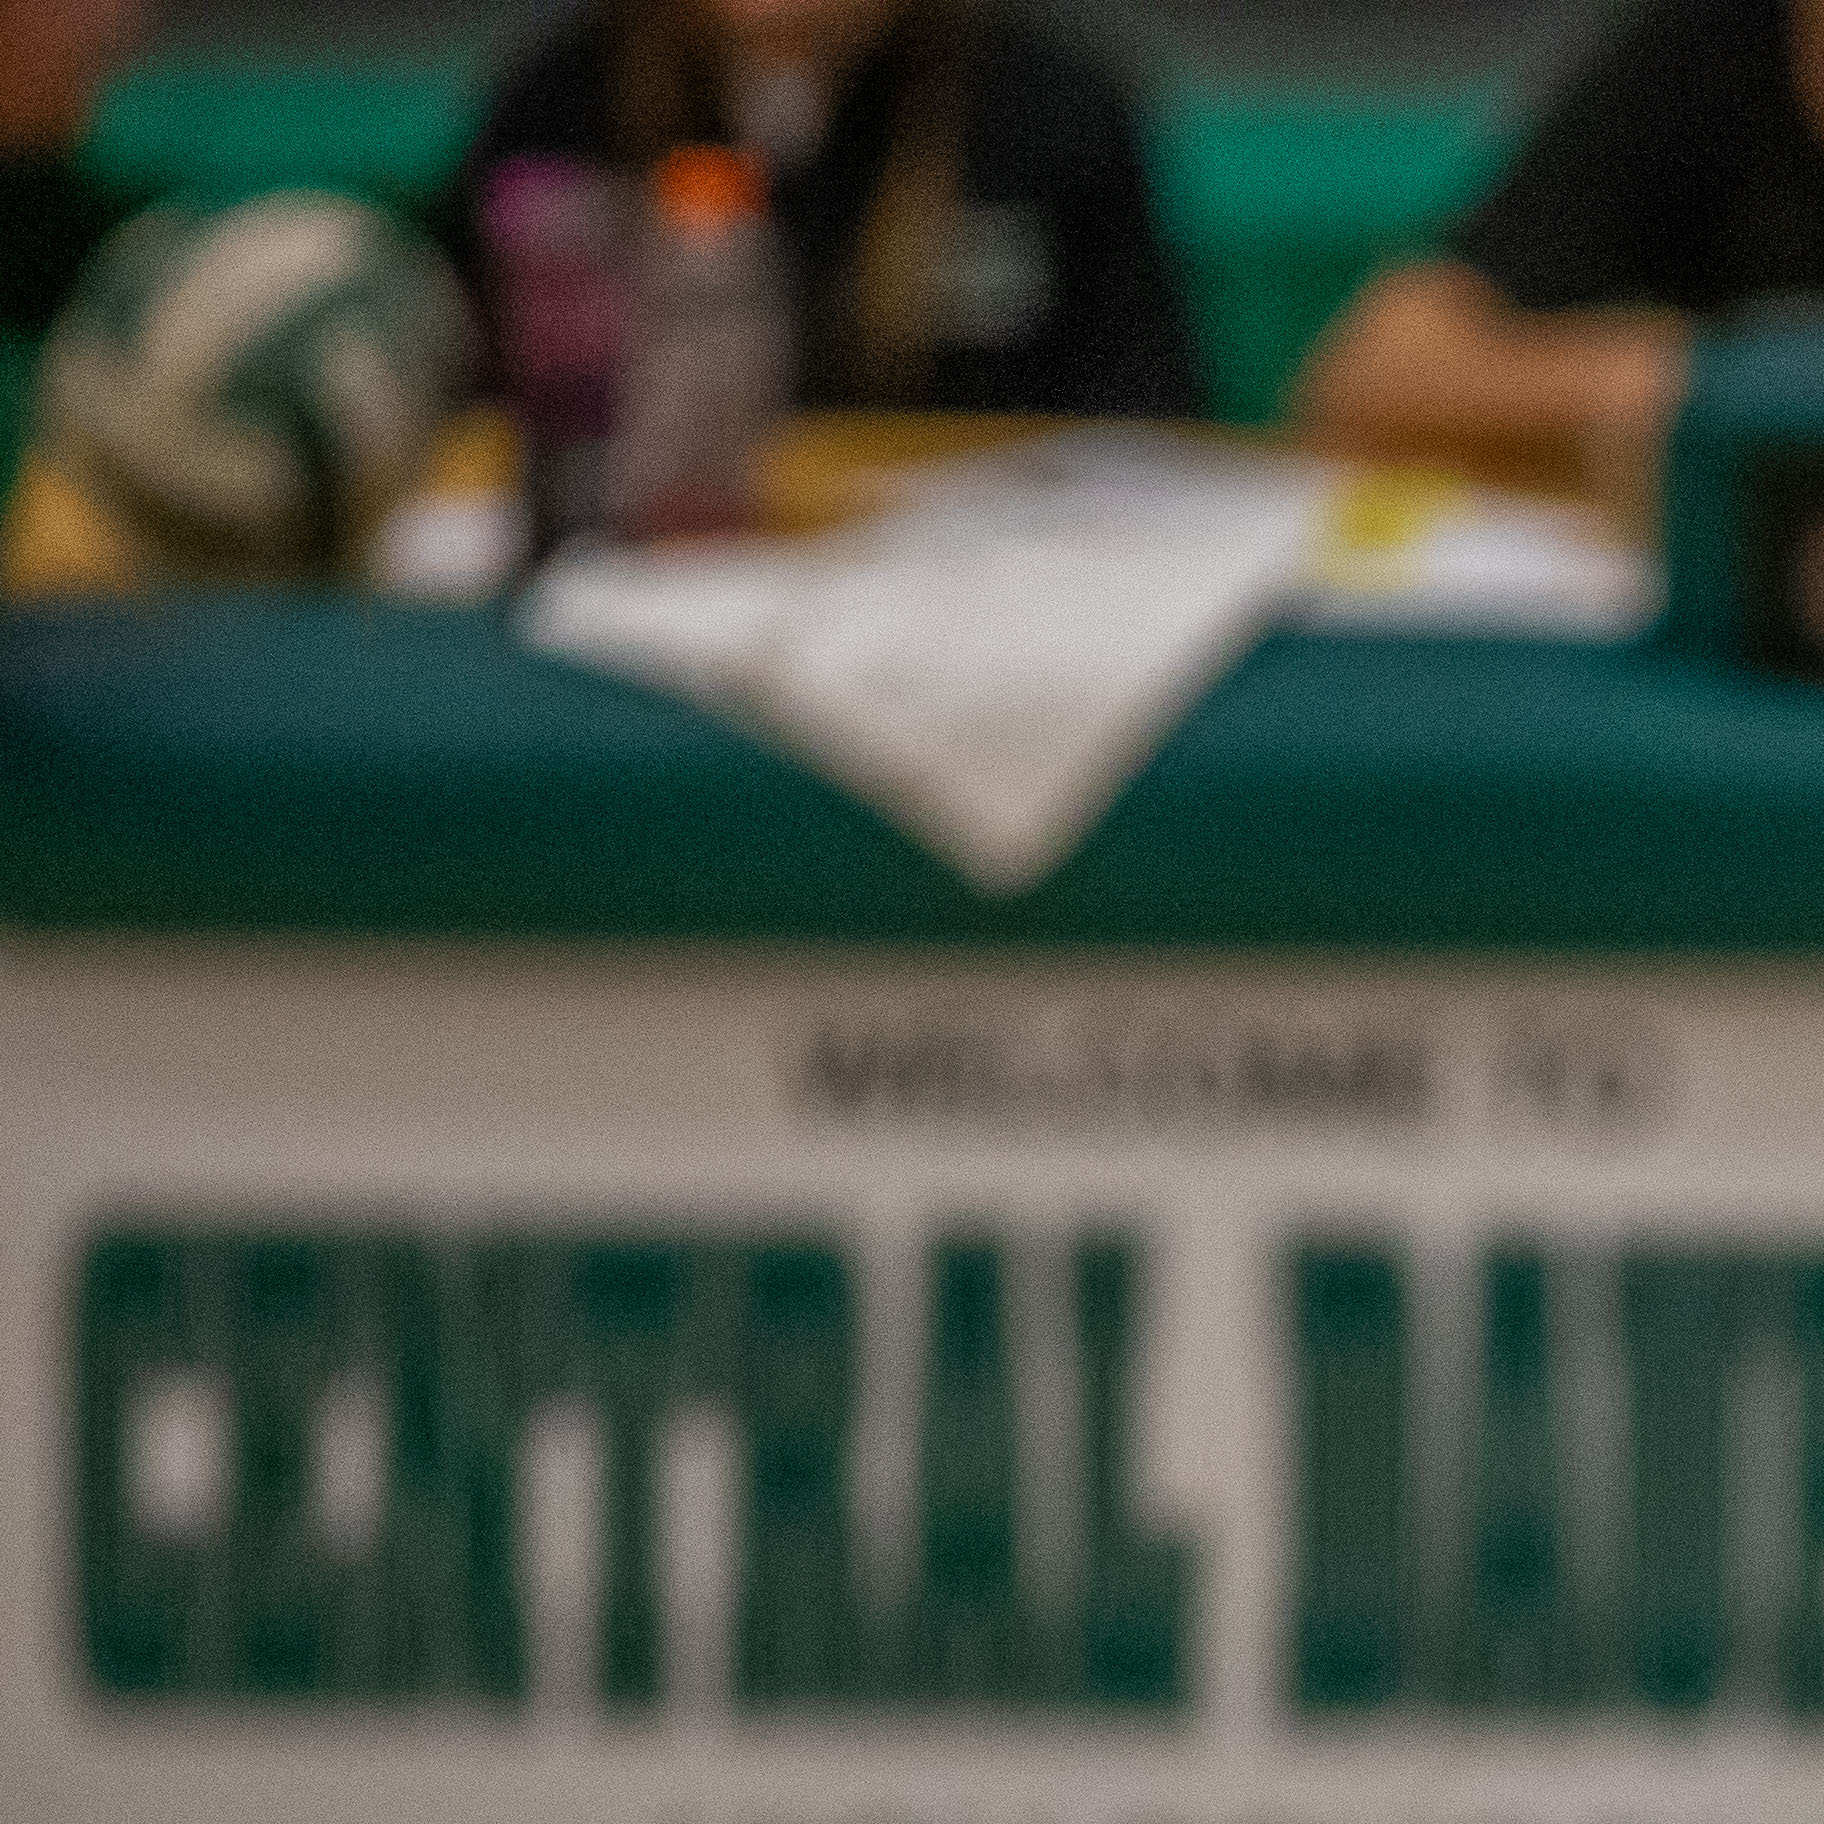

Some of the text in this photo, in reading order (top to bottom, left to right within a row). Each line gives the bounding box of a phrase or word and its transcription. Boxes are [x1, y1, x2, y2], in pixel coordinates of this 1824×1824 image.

[795, 1022, 1655, 1122] WELCOME TO
[76, 1220, 1204, 1710] CENTRAL
